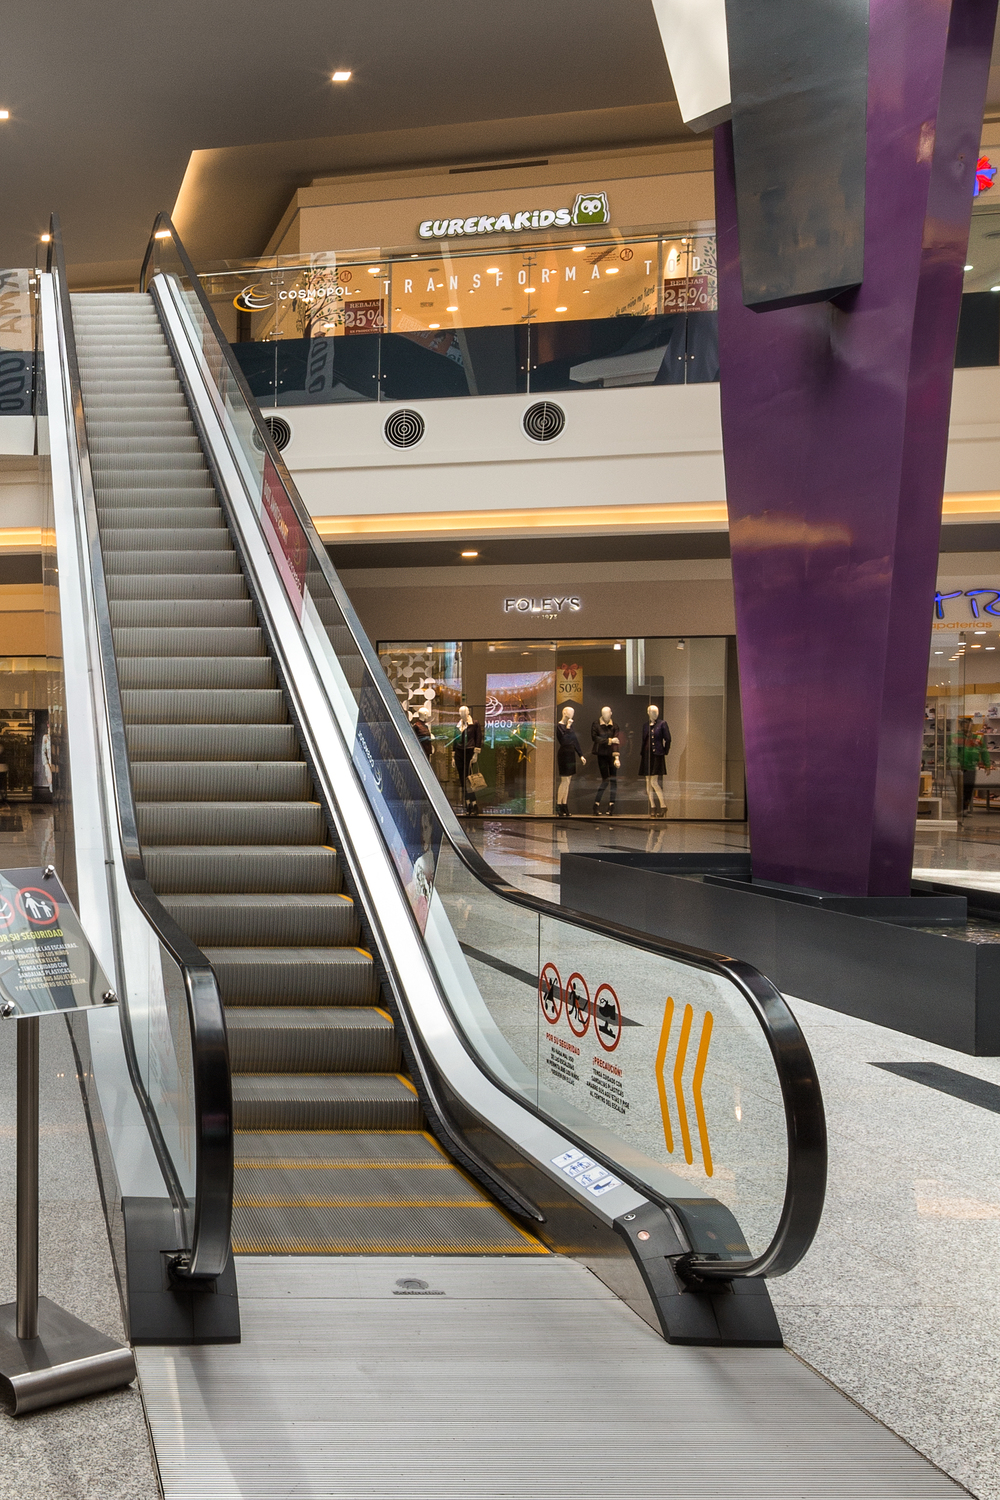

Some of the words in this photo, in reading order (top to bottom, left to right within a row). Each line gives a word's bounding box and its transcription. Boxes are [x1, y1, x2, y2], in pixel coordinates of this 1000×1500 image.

[278, 286, 352, 300] COSMOPOL
[664, 287, 708, 306] 25%
[344, 309, 384, 327] 25%
[504, 597, 581, 612] FOLEY'S
[932, 621, 993, 630] apaterias
[558, 683, 582, 693] 50%
[10, 933, 20, 941] SU
[21, 929, 63, 940] SEGURIDAD
